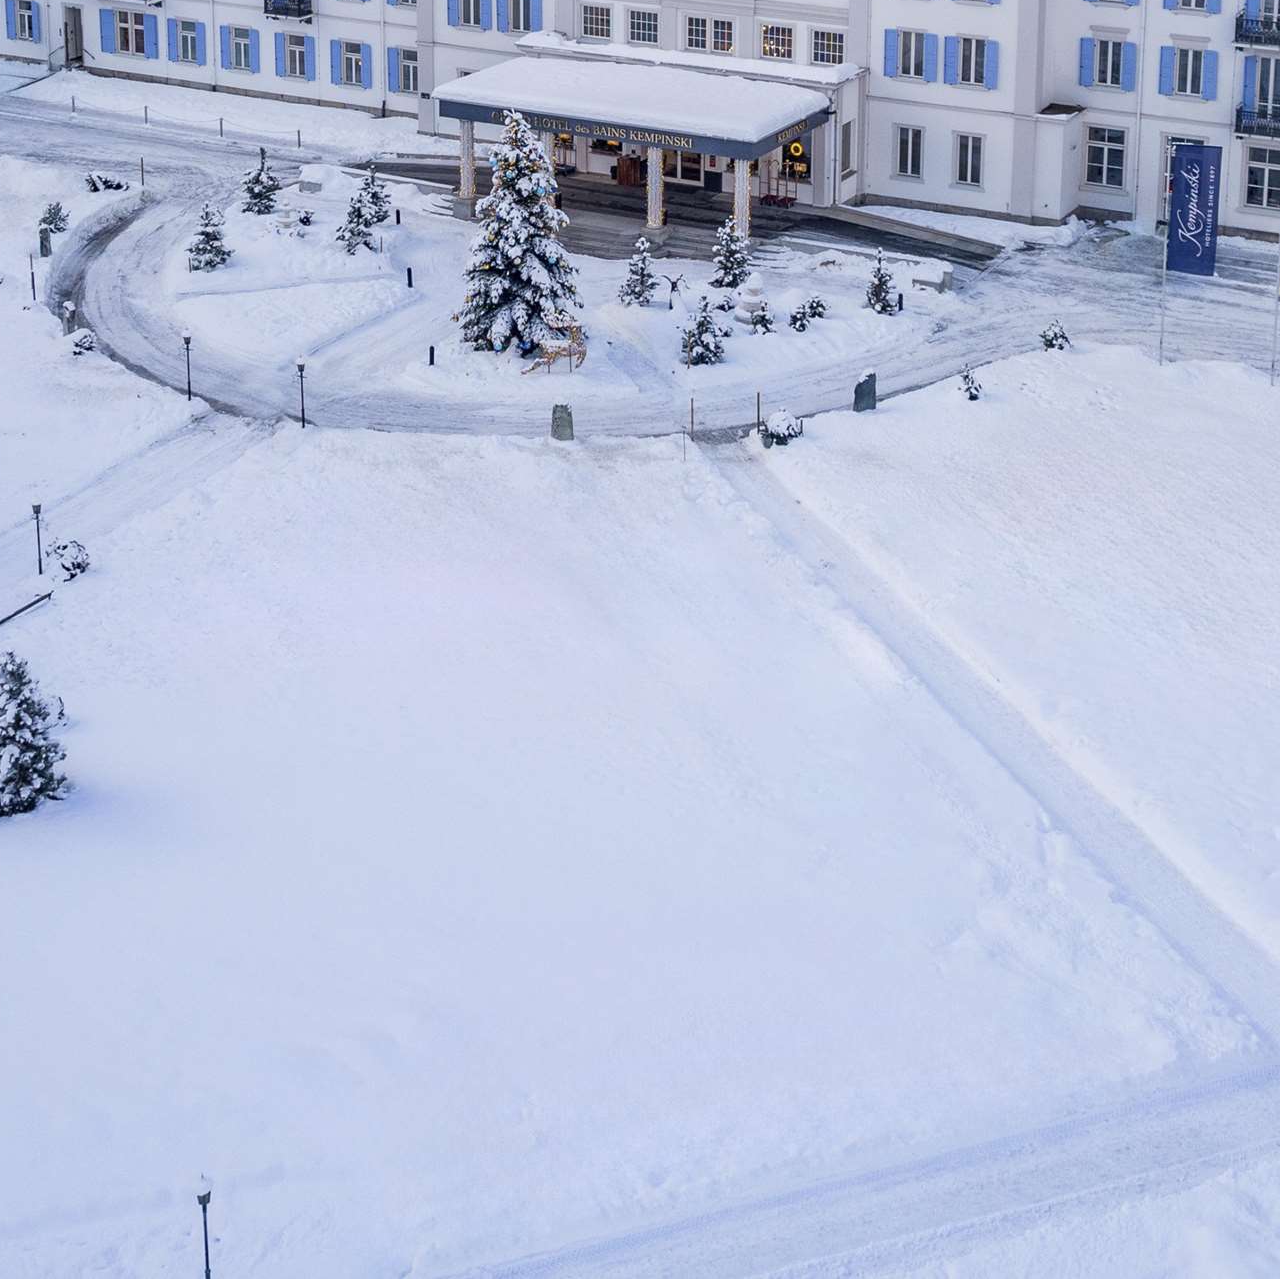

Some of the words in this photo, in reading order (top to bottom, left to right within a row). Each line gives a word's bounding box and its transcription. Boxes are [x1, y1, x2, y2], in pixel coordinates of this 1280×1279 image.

[534, 116, 572, 131] HOTEL
[575, 124, 590, 134] des
[593, 125, 626, 139] BAINS
[629, 130, 693, 149] KEMPINSKI
[1177, 163, 1206, 257] Kempinski
[1205, 209, 1213, 247] HOTELIERS
